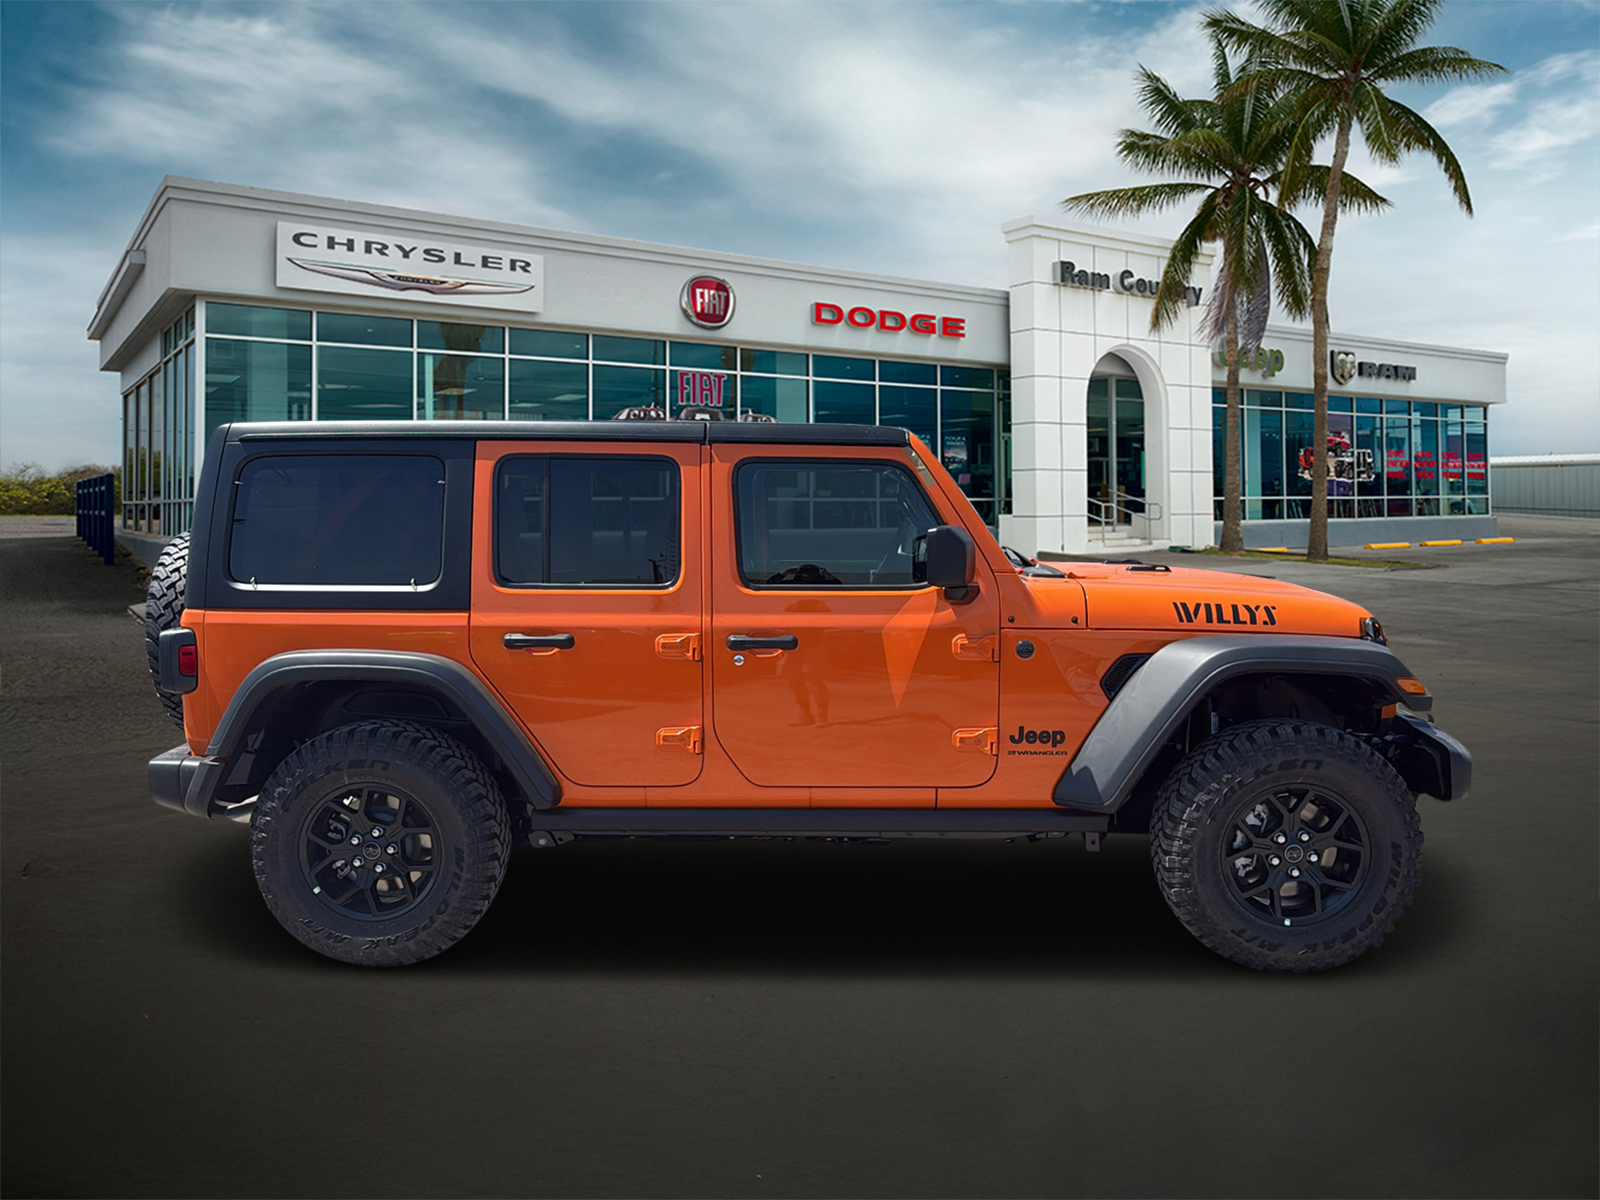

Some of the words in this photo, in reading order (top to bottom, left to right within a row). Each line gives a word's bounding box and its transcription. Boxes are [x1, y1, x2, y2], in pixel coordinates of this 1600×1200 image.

[291, 232, 532, 274] CHRYSLER
[1053, 260, 1110, 291] Ram
[1113, 269, 1203, 308] Coury
[695, 288, 727, 316] FIAT
[811, 301, 967, 339] DODGE
[1358, 361, 1417, 381] RAM
[678, 371, 727, 406] FIAT
[1172, 602, 1277, 626] WILLYS
[1009, 726, 1066, 747] Jeep
